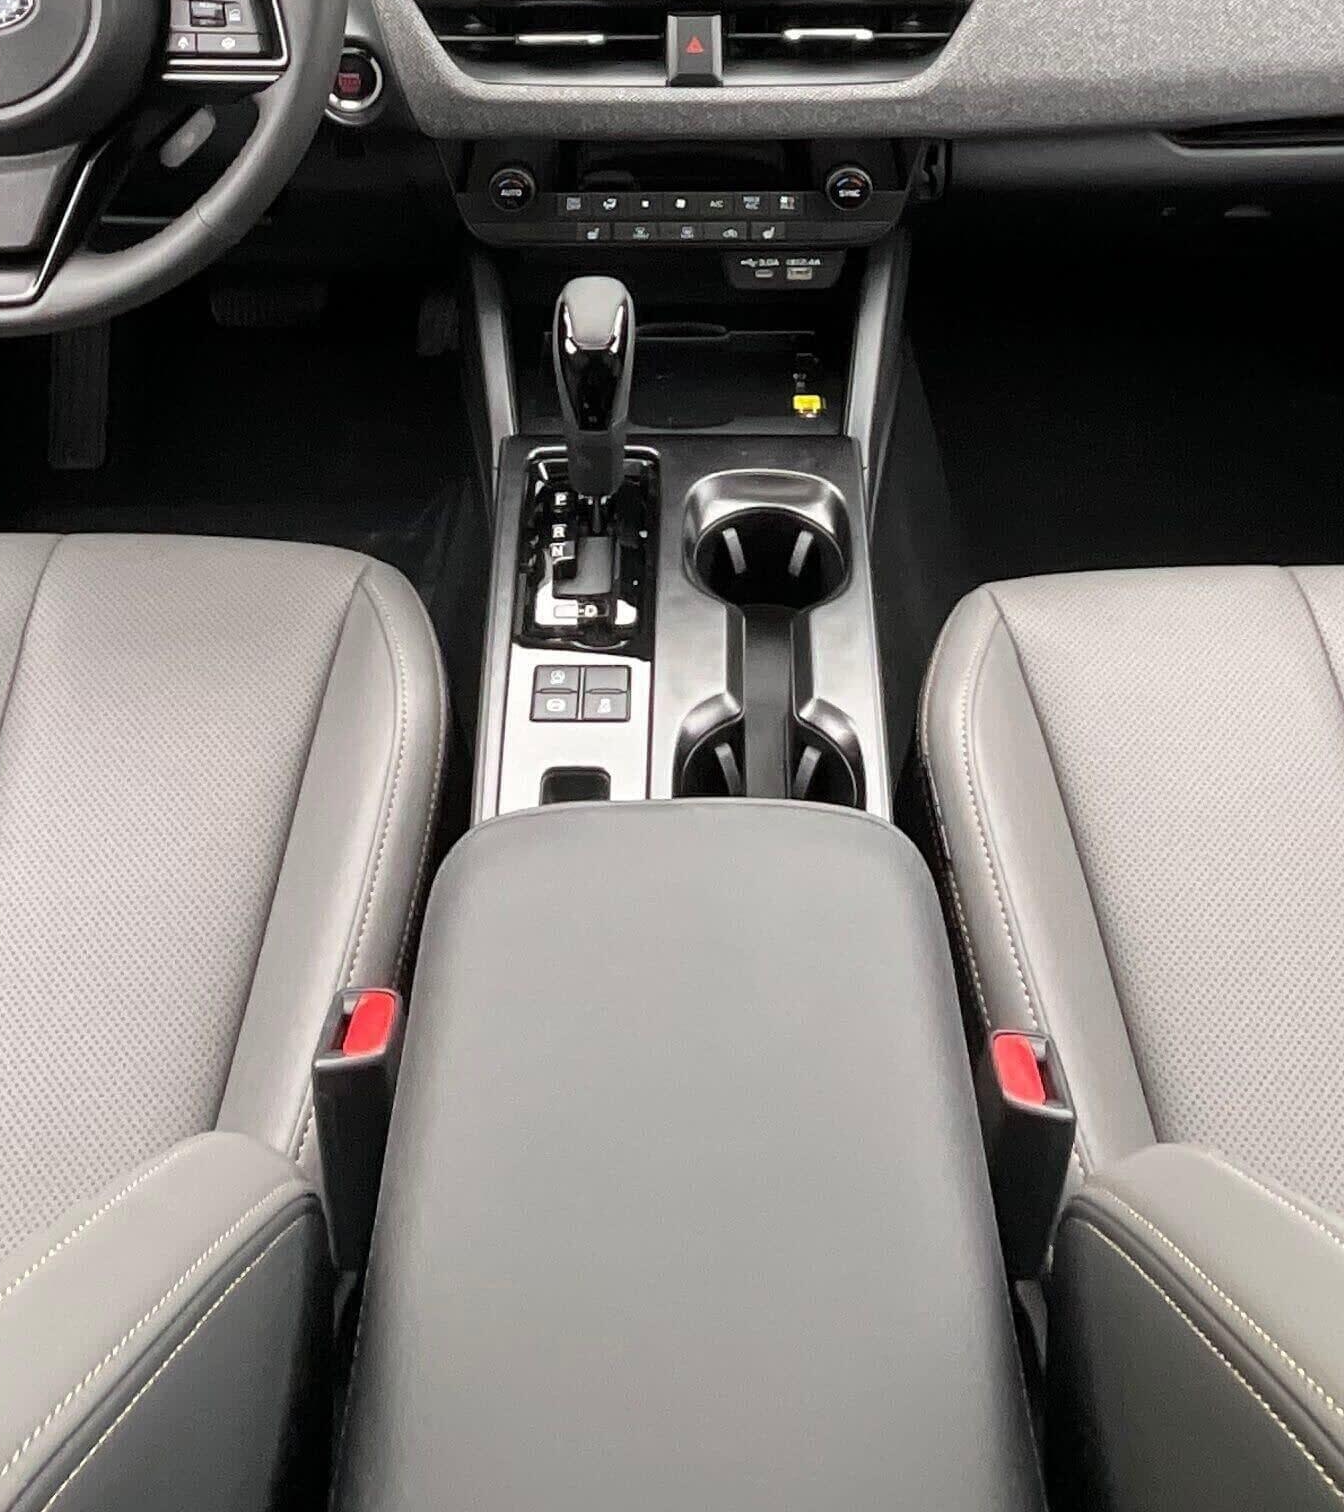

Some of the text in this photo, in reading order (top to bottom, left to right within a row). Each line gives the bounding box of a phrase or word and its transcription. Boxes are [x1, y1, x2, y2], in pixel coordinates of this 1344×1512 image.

[555, 492, 567, 506] P
[551, 544, 564, 558] N
[583, 603, 598, 618] D
